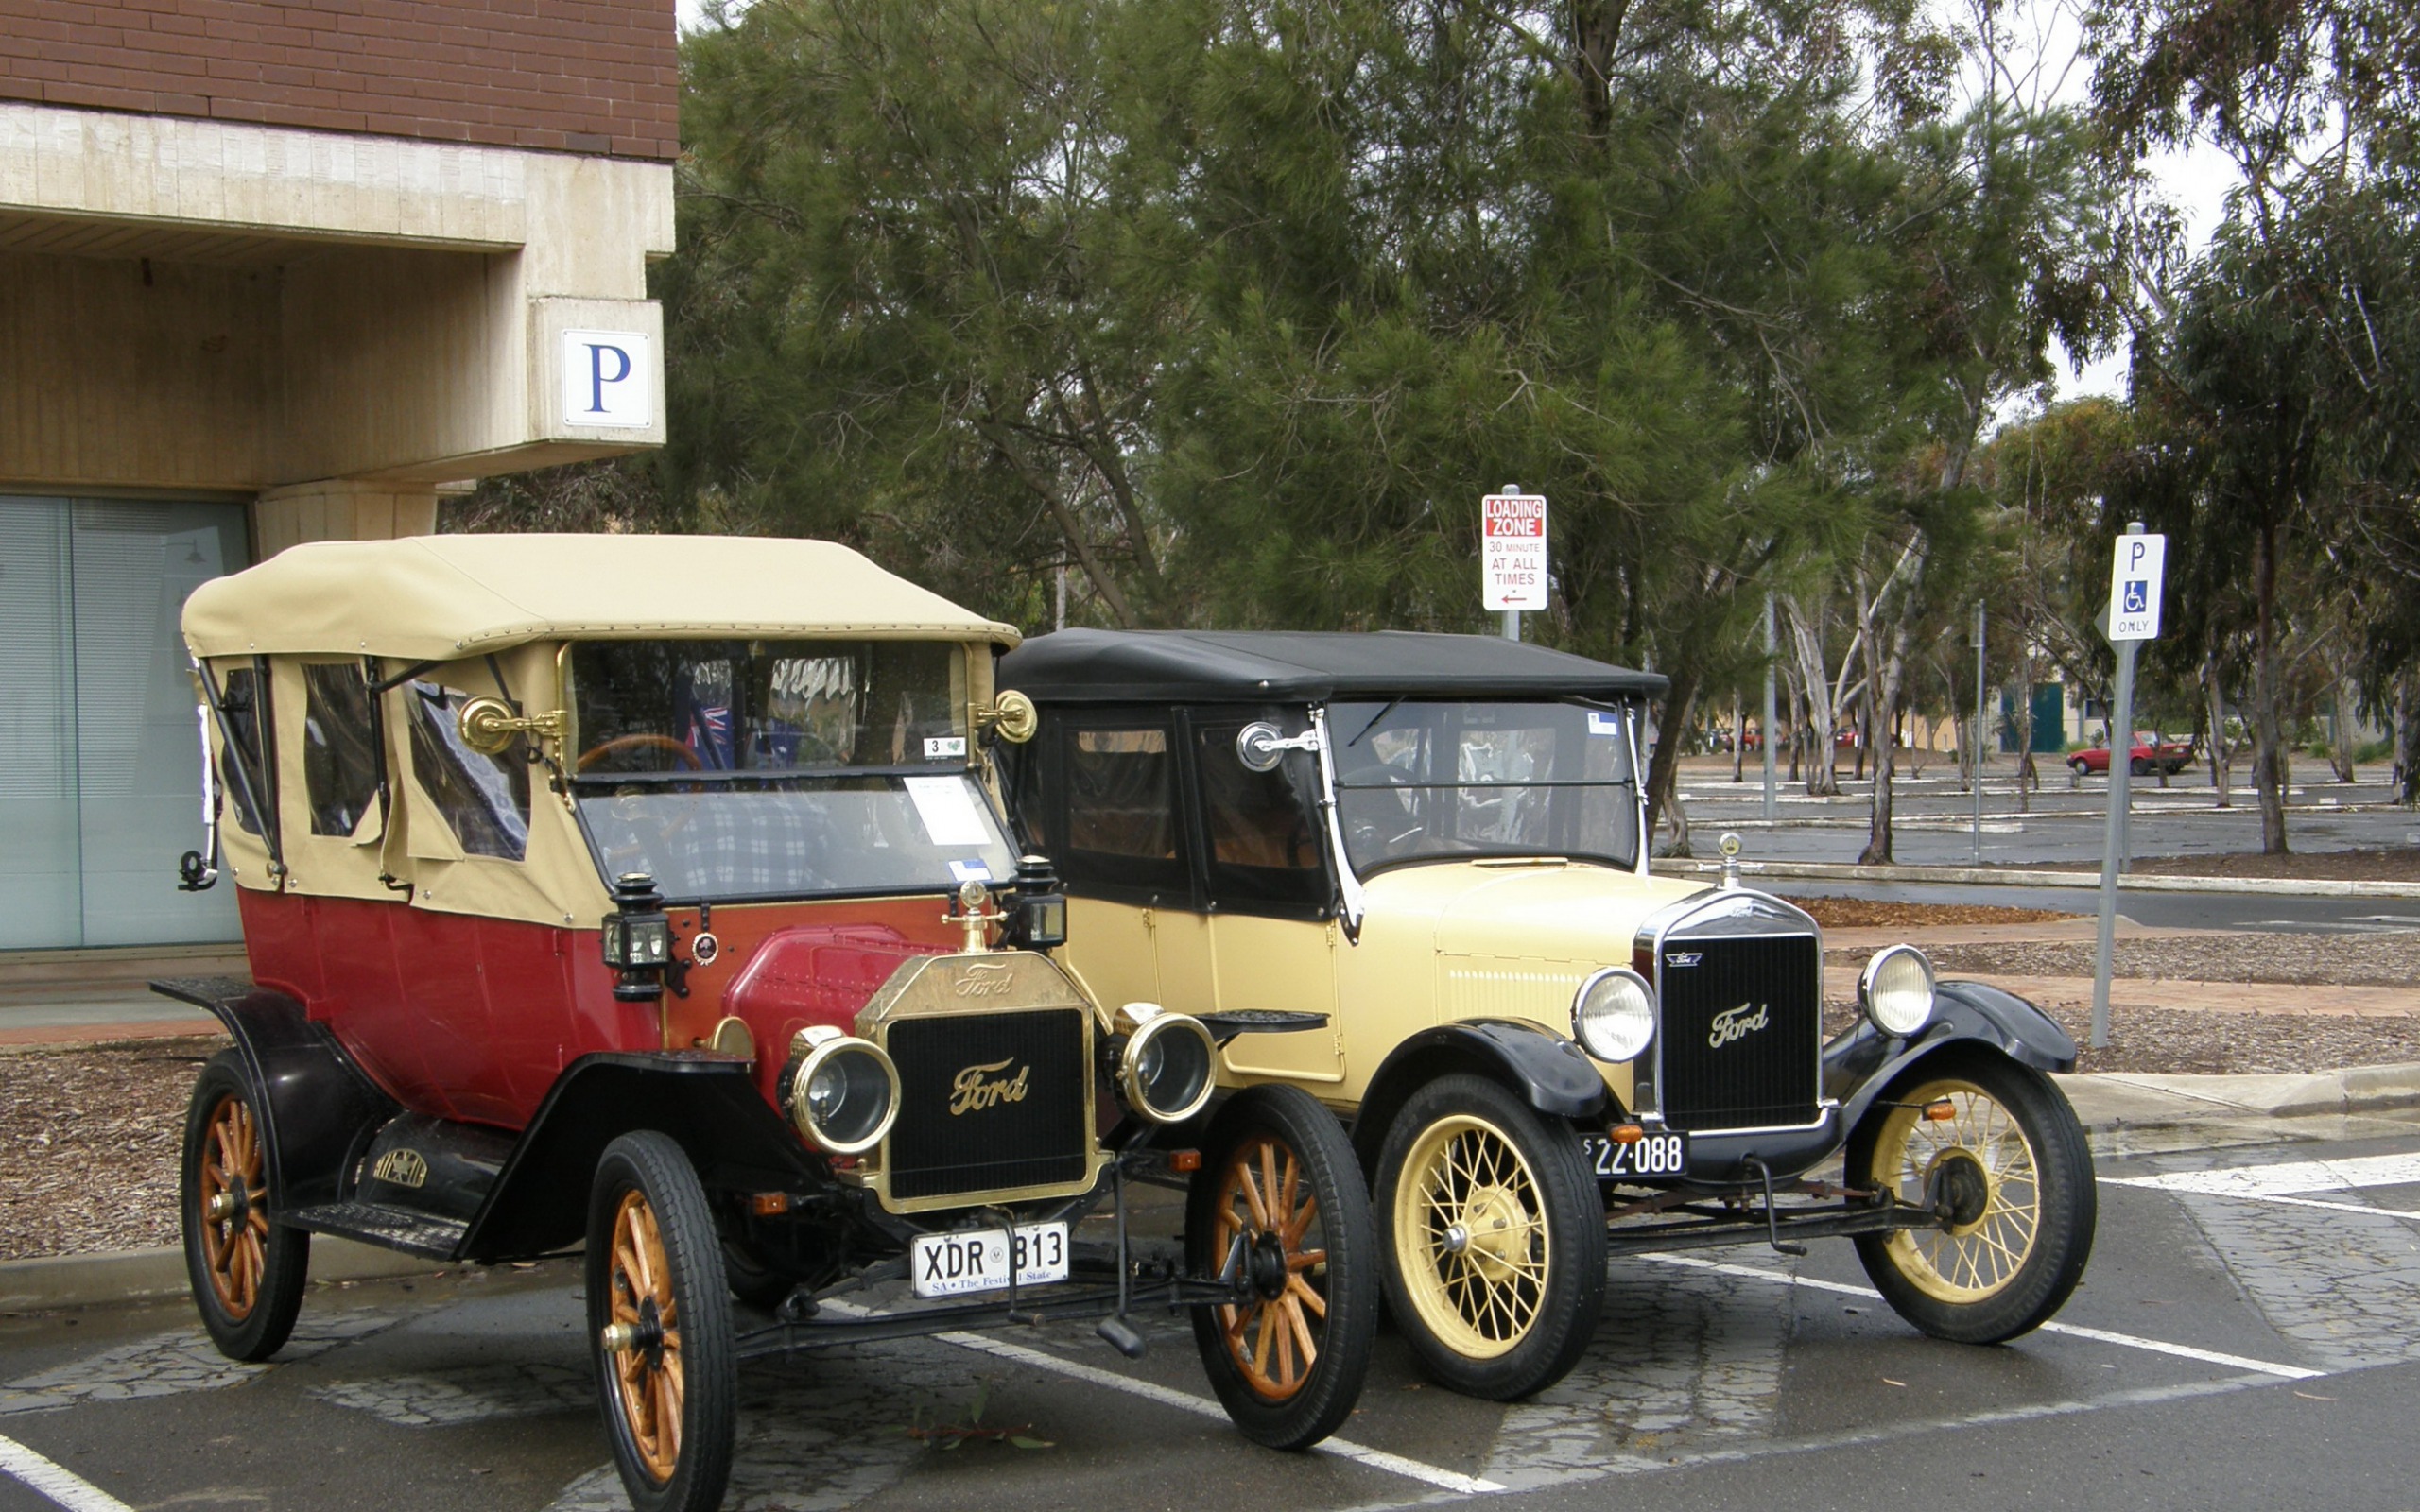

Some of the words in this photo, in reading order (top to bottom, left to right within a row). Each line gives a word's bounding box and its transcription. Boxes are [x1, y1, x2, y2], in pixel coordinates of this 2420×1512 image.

[582, 343, 631, 413] P
[1487, 500, 1542, 518] LOADING
[1493, 518, 1536, 536] ZONE
[1489, 541, 1502, 553] 30
[1506, 543, 1540, 553] MINUTE
[2131, 541, 2145, 572] P
[1492, 558, 1507, 570] AT
[1512, 558, 1537, 570] ALL
[1495, 573, 1535, 585] TIMES
[2118, 620, 2149, 633] ONLY
[931, 739, 939, 753] 3
[955, 963, 1013, 997] Ford
[1708, 1002, 1770, 1049] Ford
[949, 1056, 1030, 1116] Ford
[924, 1240, 984, 1281] XDR
[1014, 1231, 1062, 1270] 813
[932, 1282, 947, 1293] SA
[959, 1279, 978, 1289] The
[983, 1272, 1022, 1286] Festivl
[1026, 1271, 1051, 1281] State
